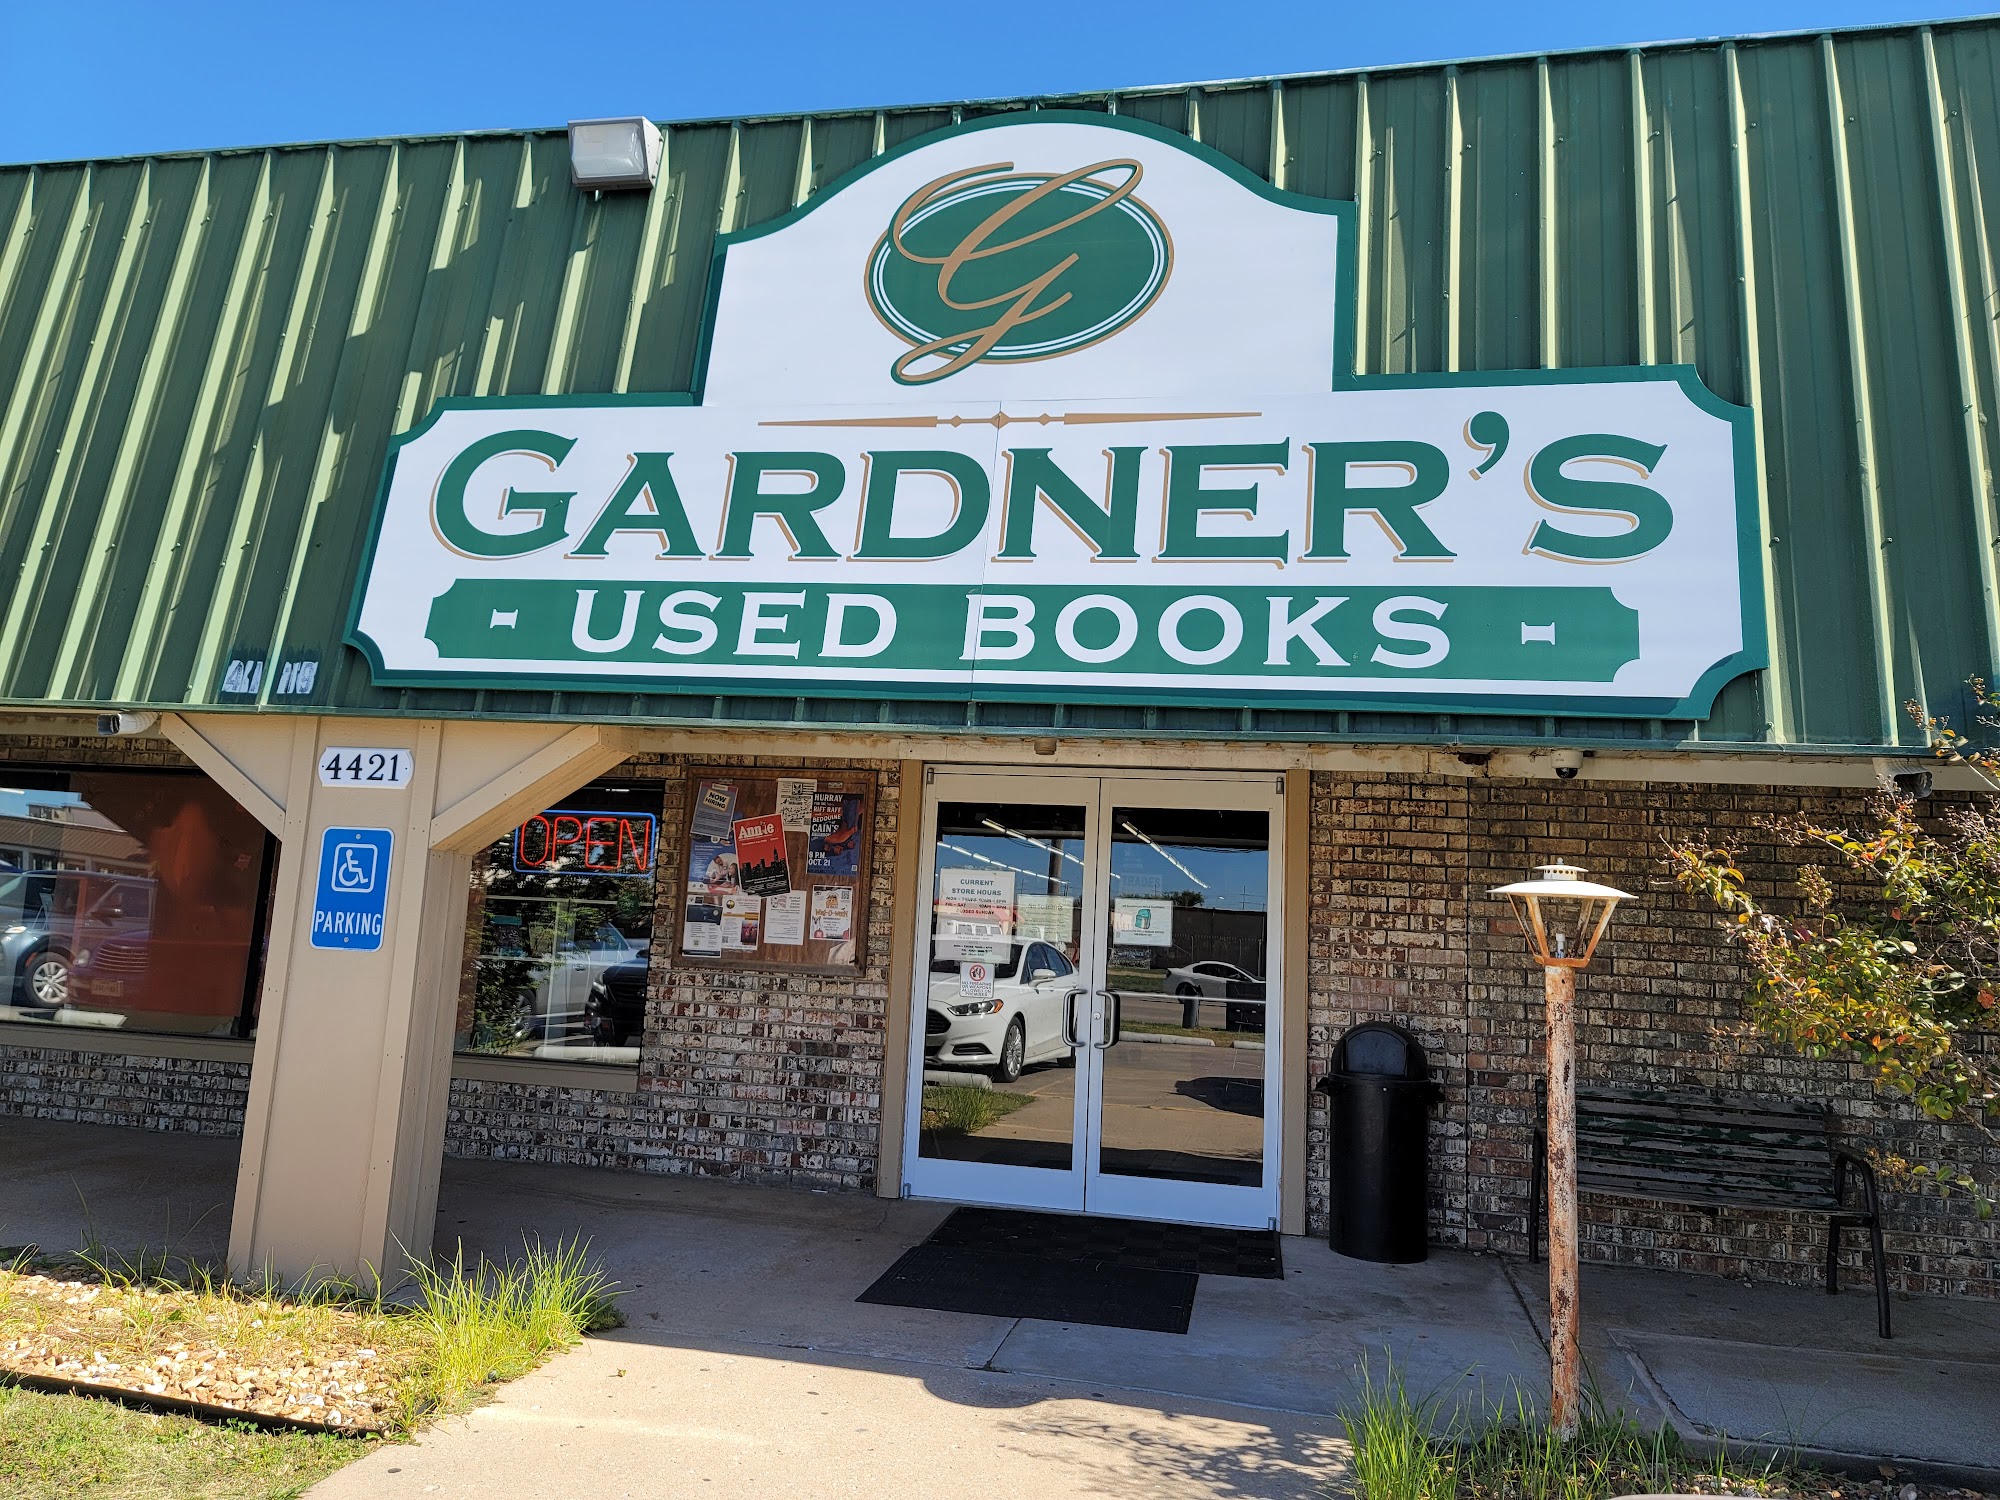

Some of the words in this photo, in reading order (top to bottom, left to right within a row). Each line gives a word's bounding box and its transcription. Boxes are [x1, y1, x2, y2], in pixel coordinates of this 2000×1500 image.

[430, 411, 1674, 567] GARDNER'S
[571, 588, 897, 660] USED
[959, 593, 1450, 669] BOOKS
[325, 753, 400, 782] 4421
[704, 797, 726, 809] HIRING
[708, 791, 727, 803] NOW
[814, 793, 843, 803] HURRAY
[738, 820, 775, 839] Annie
[811, 823, 839, 833] CAIN'S
[519, 814, 651, 871] OPEN
[823, 859, 831, 867] 21
[960, 878, 994, 886] CURRENT
[314, 910, 382, 936] PARKING
